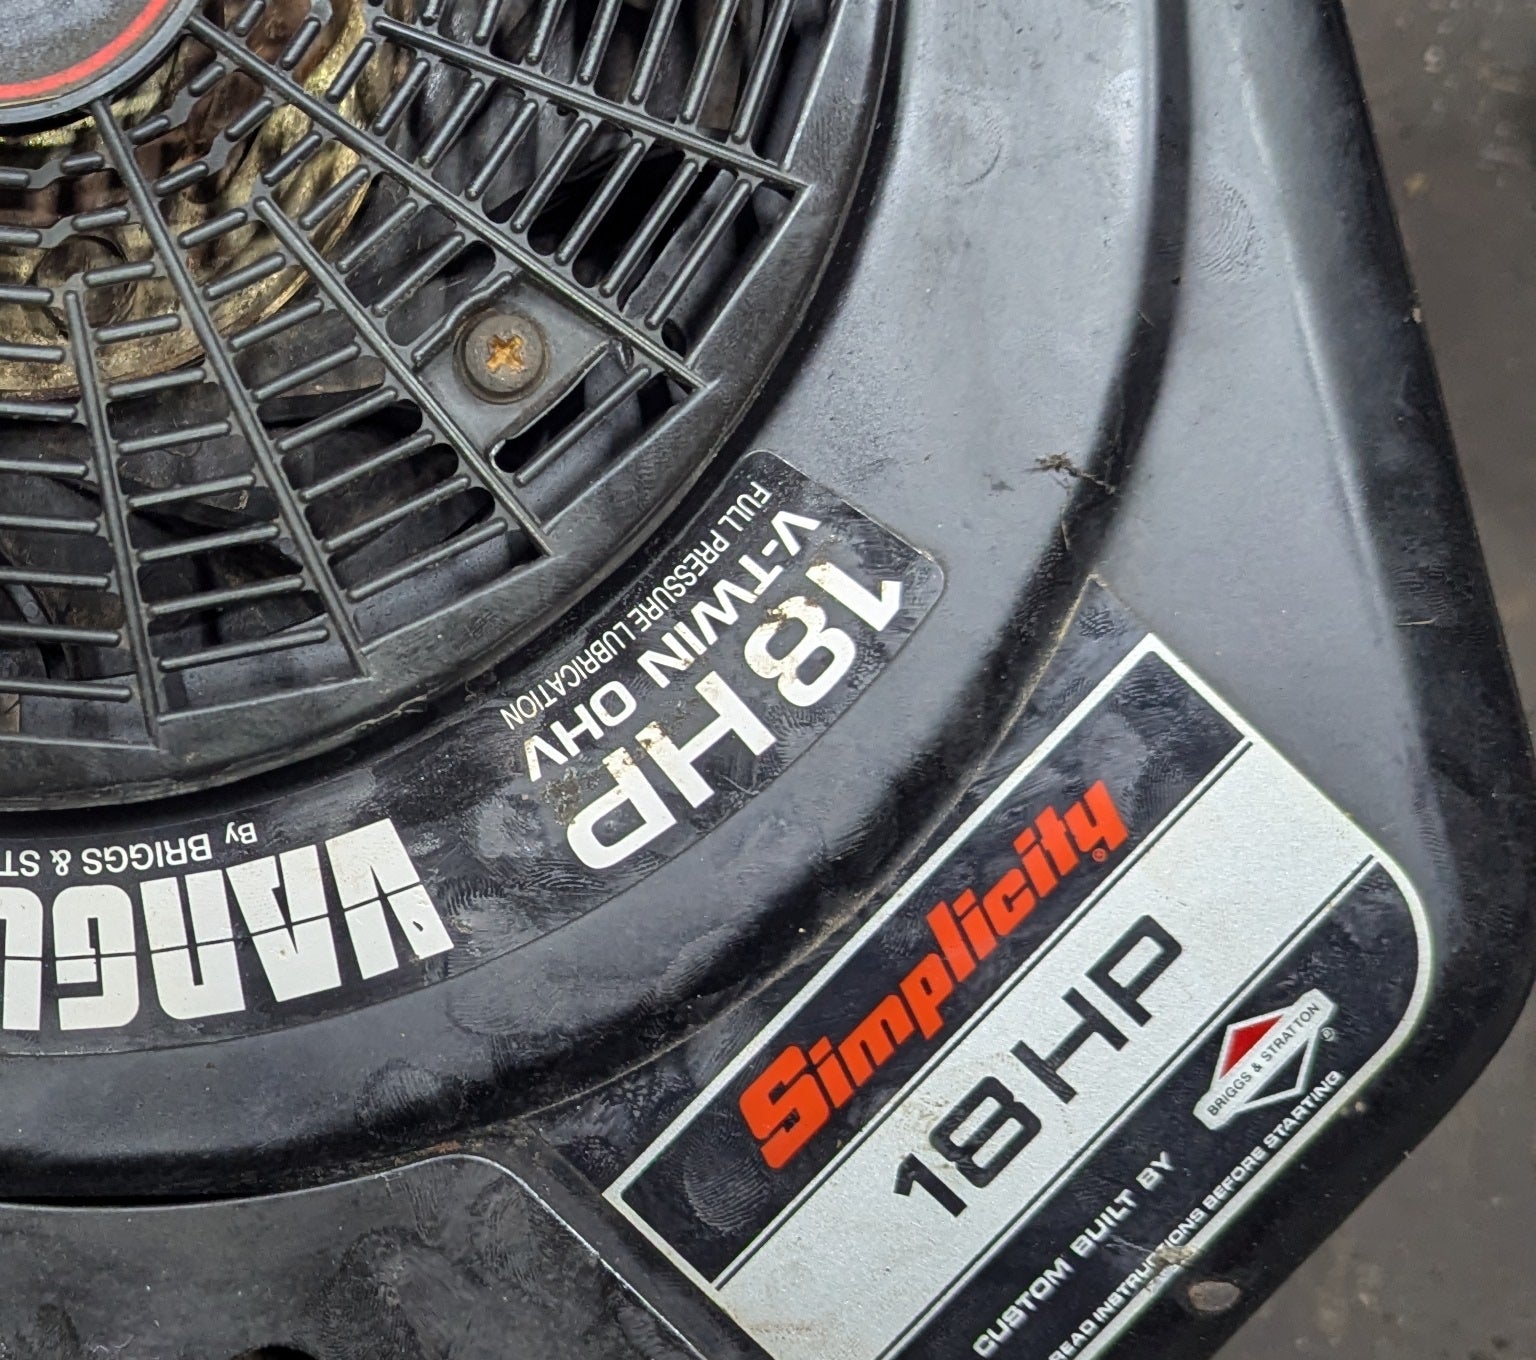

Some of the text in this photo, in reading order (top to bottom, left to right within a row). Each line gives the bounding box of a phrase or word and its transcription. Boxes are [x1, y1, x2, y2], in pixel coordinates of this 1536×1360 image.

[499, 481, 772, 731] FULL PRESSURE LUBRICATION
[524, 510, 822, 782] V-TWIN OHV
[566, 561, 903, 870] 18 HP
[50, 849, 72, 876] &
[82, 833, 213, 875] BRIGGS
[225, 822, 258, 845] By
[739, 779, 1129, 1169] Simplicity
[893, 914, 1183, 1217] 18 HP
[1207, 1002, 1321, 1117] BRIGGS & STRATTON
[1206, 1149, 1267, 1211] BEFORE
[1263, 1070, 1346, 1151] STARTING
[972, 1151, 1177, 1359] CUSTOM BUILT BY
